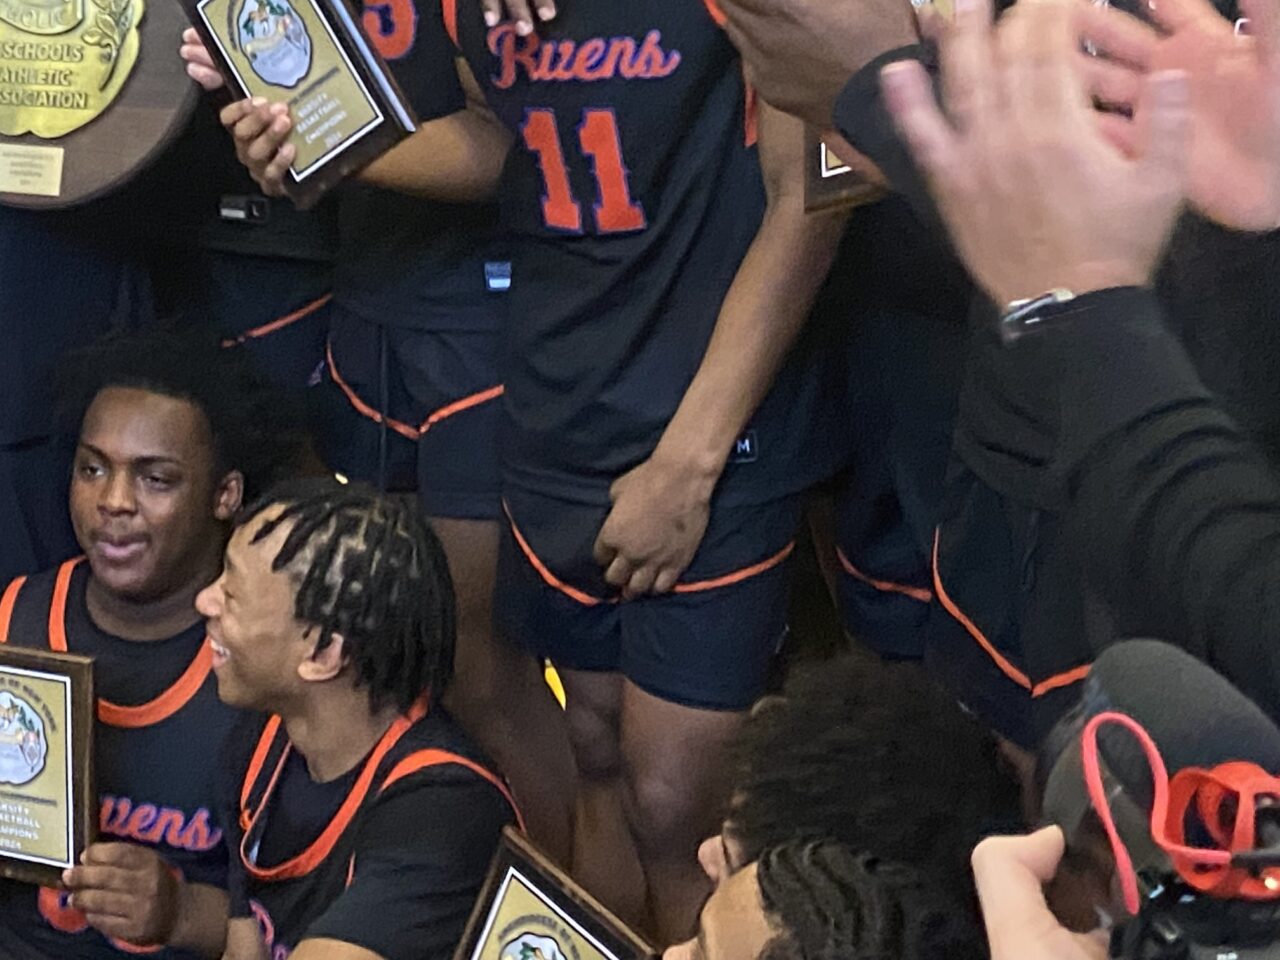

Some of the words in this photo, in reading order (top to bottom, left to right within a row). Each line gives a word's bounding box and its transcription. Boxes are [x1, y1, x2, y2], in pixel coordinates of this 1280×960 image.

[1, 41, 85, 63] SCHOOLS
[487, 20, 682, 89] Rvens
[522, 107, 648, 237] 11
[736, 438, 751, 454] M
[98, 794, 223, 852] vens
